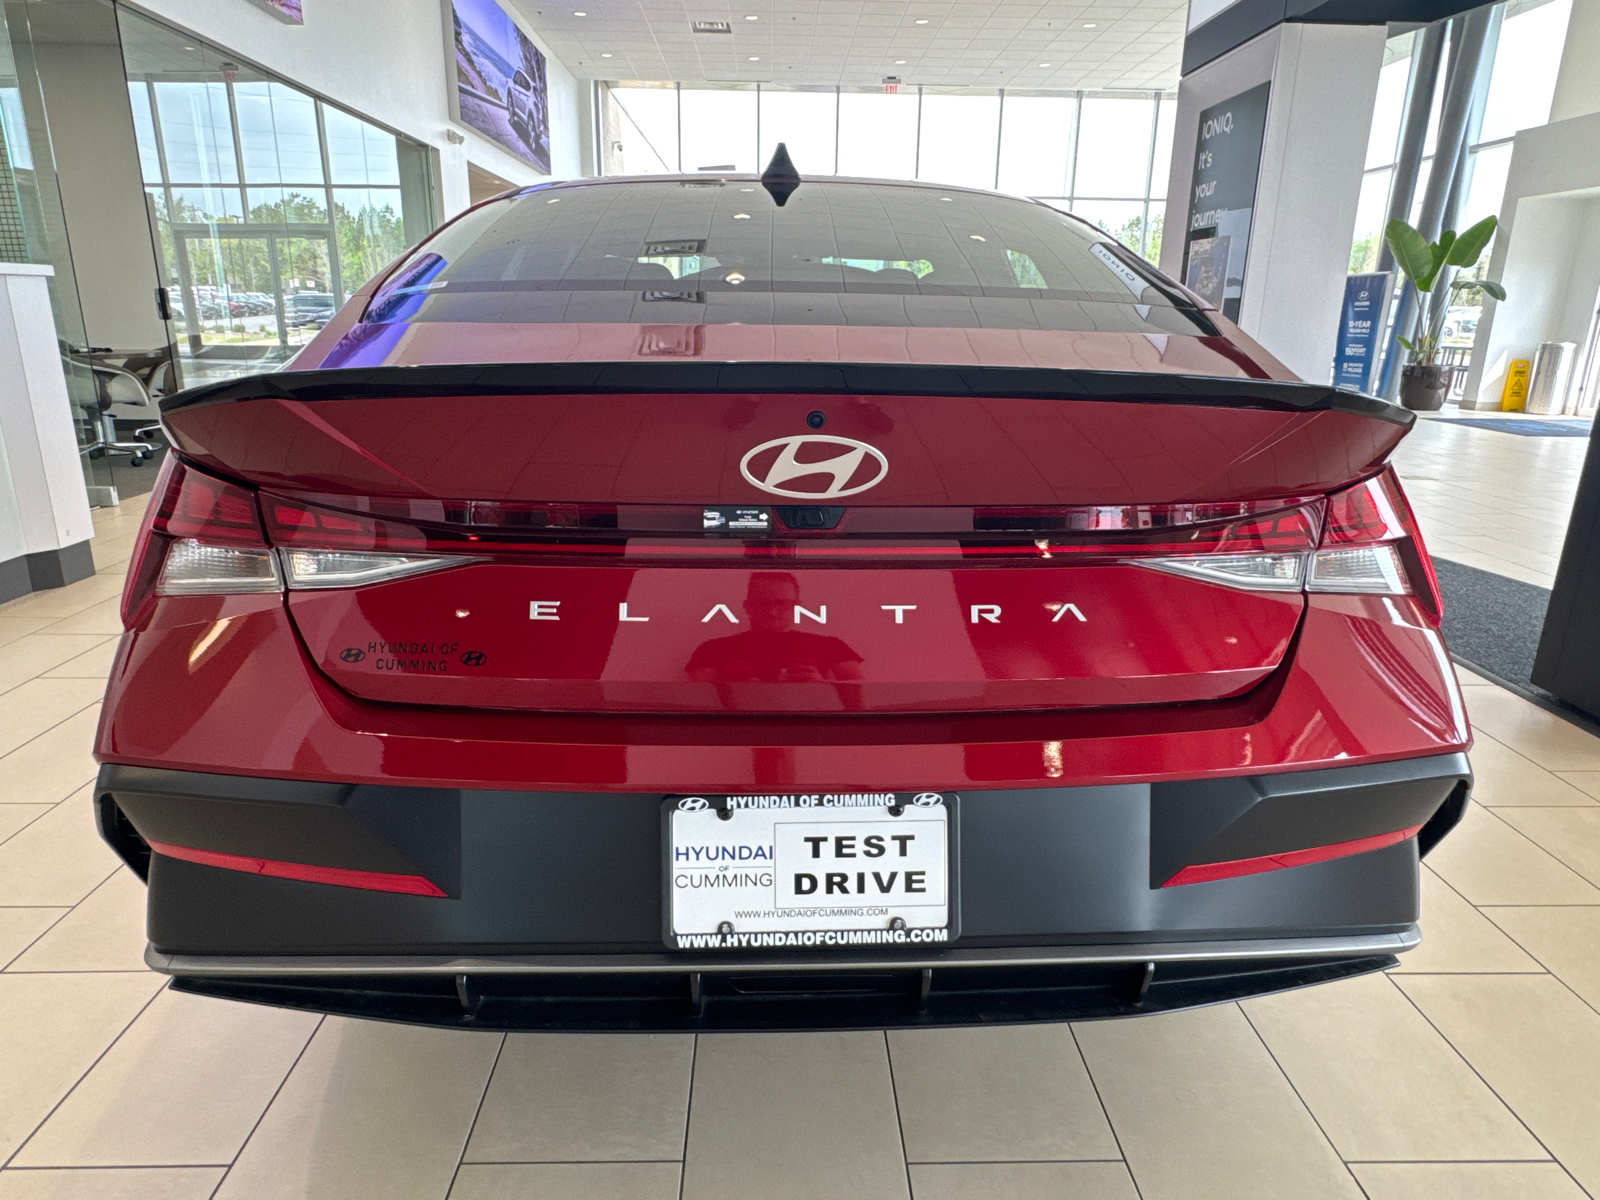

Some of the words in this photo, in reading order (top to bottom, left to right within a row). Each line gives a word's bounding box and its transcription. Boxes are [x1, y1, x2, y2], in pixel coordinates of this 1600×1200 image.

[1202, 111, 1234, 141] IONIQ.
[1198, 150, 1213, 171] It's
[1195, 180, 1217, 203] your
[1348, 320, 1371, 328] 10-YEAR
[529, 600, 1088, 625] ELANTRA
[367, 641, 435, 655] HYUNDAI
[441, 643, 459, 656] OF
[376, 658, 448, 672] CUMMING
[726, 794, 796, 810] HYUNDAI
[799, 794, 820, 809] OF
[823, 793, 896, 807] CUMMING
[675, 845, 773, 862] HYUNDAI
[803, 834, 915, 859] TEST
[675, 872, 773, 889] CUMMING
[794, 870, 927, 895] DRIVE
[734, 907, 889, 919] WWW.HYUNDAIOFCUMMING.COM
[676, 928, 948, 949] WWW.HYUNDAIOFCUMMING.COM
